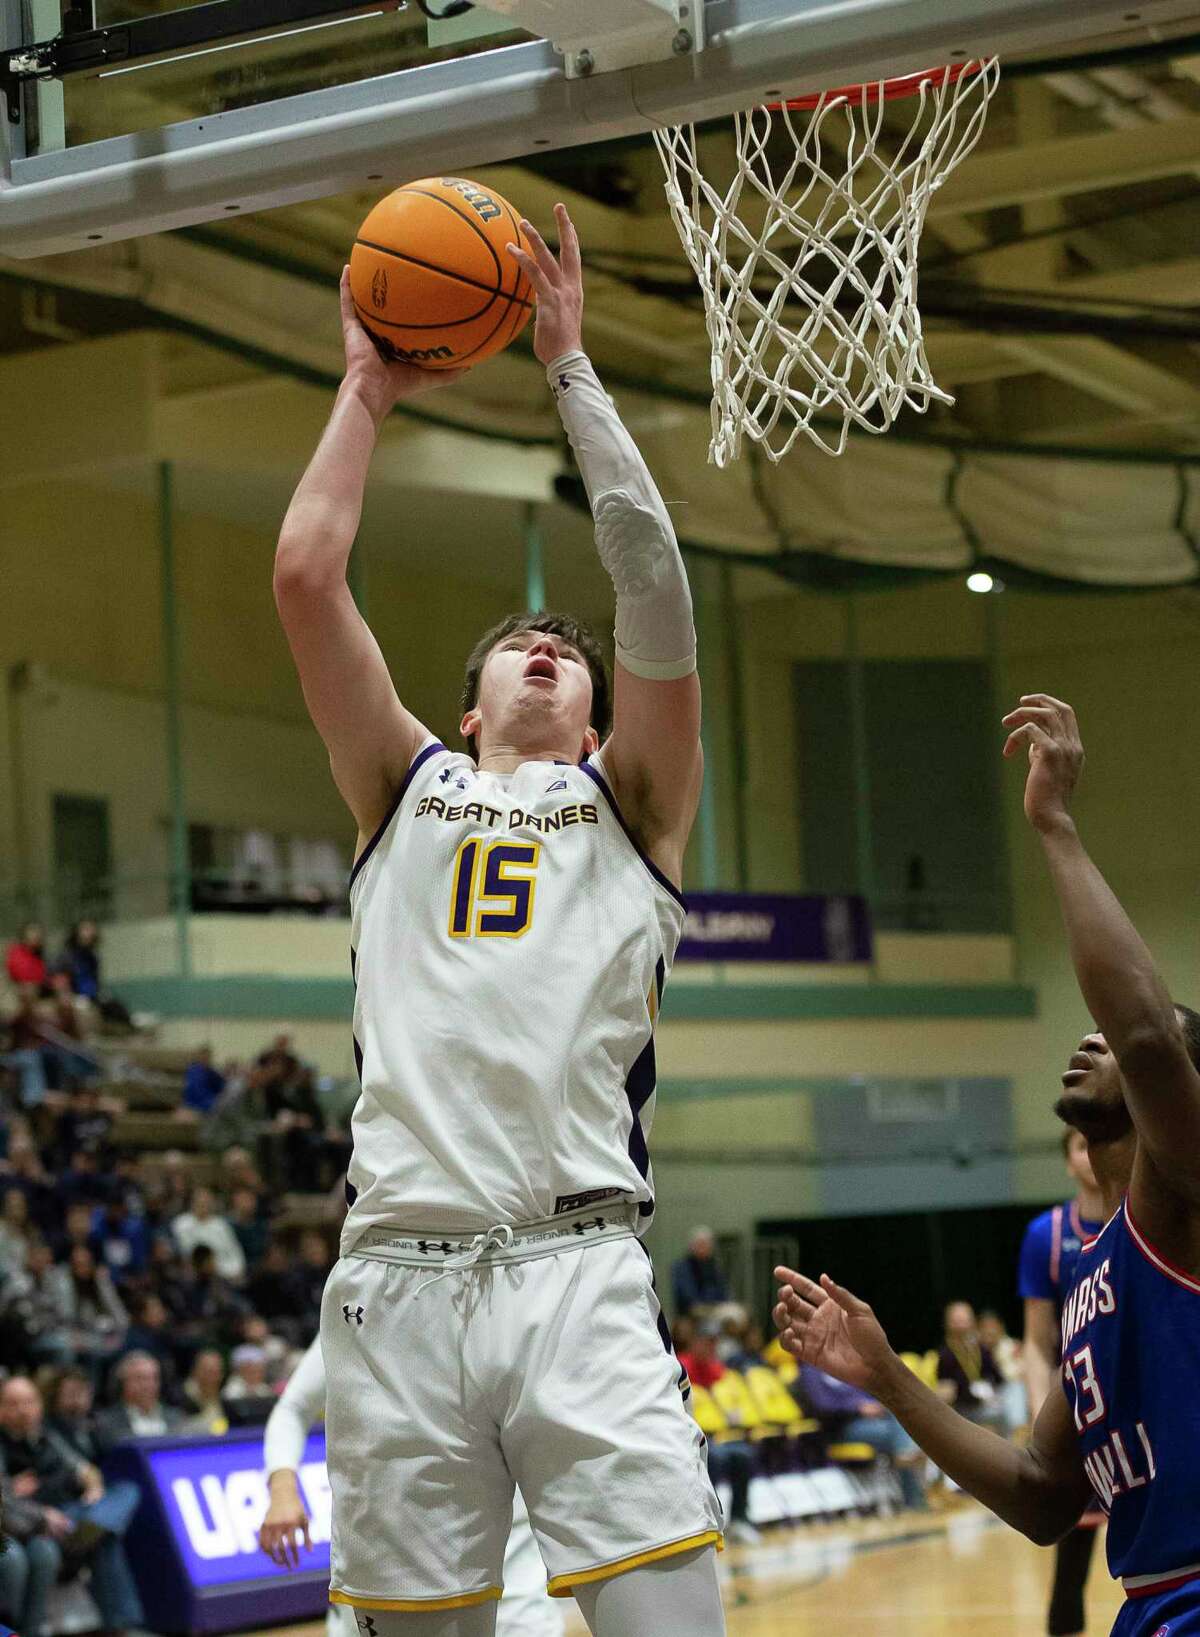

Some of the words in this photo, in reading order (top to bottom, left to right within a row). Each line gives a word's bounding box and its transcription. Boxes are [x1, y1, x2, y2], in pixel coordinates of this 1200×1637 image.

[414, 796, 502, 828] GREAT
[508, 803, 599, 833] DANES
[448, 837, 542, 939] 15
[1064, 1343, 1108, 1434] 13
